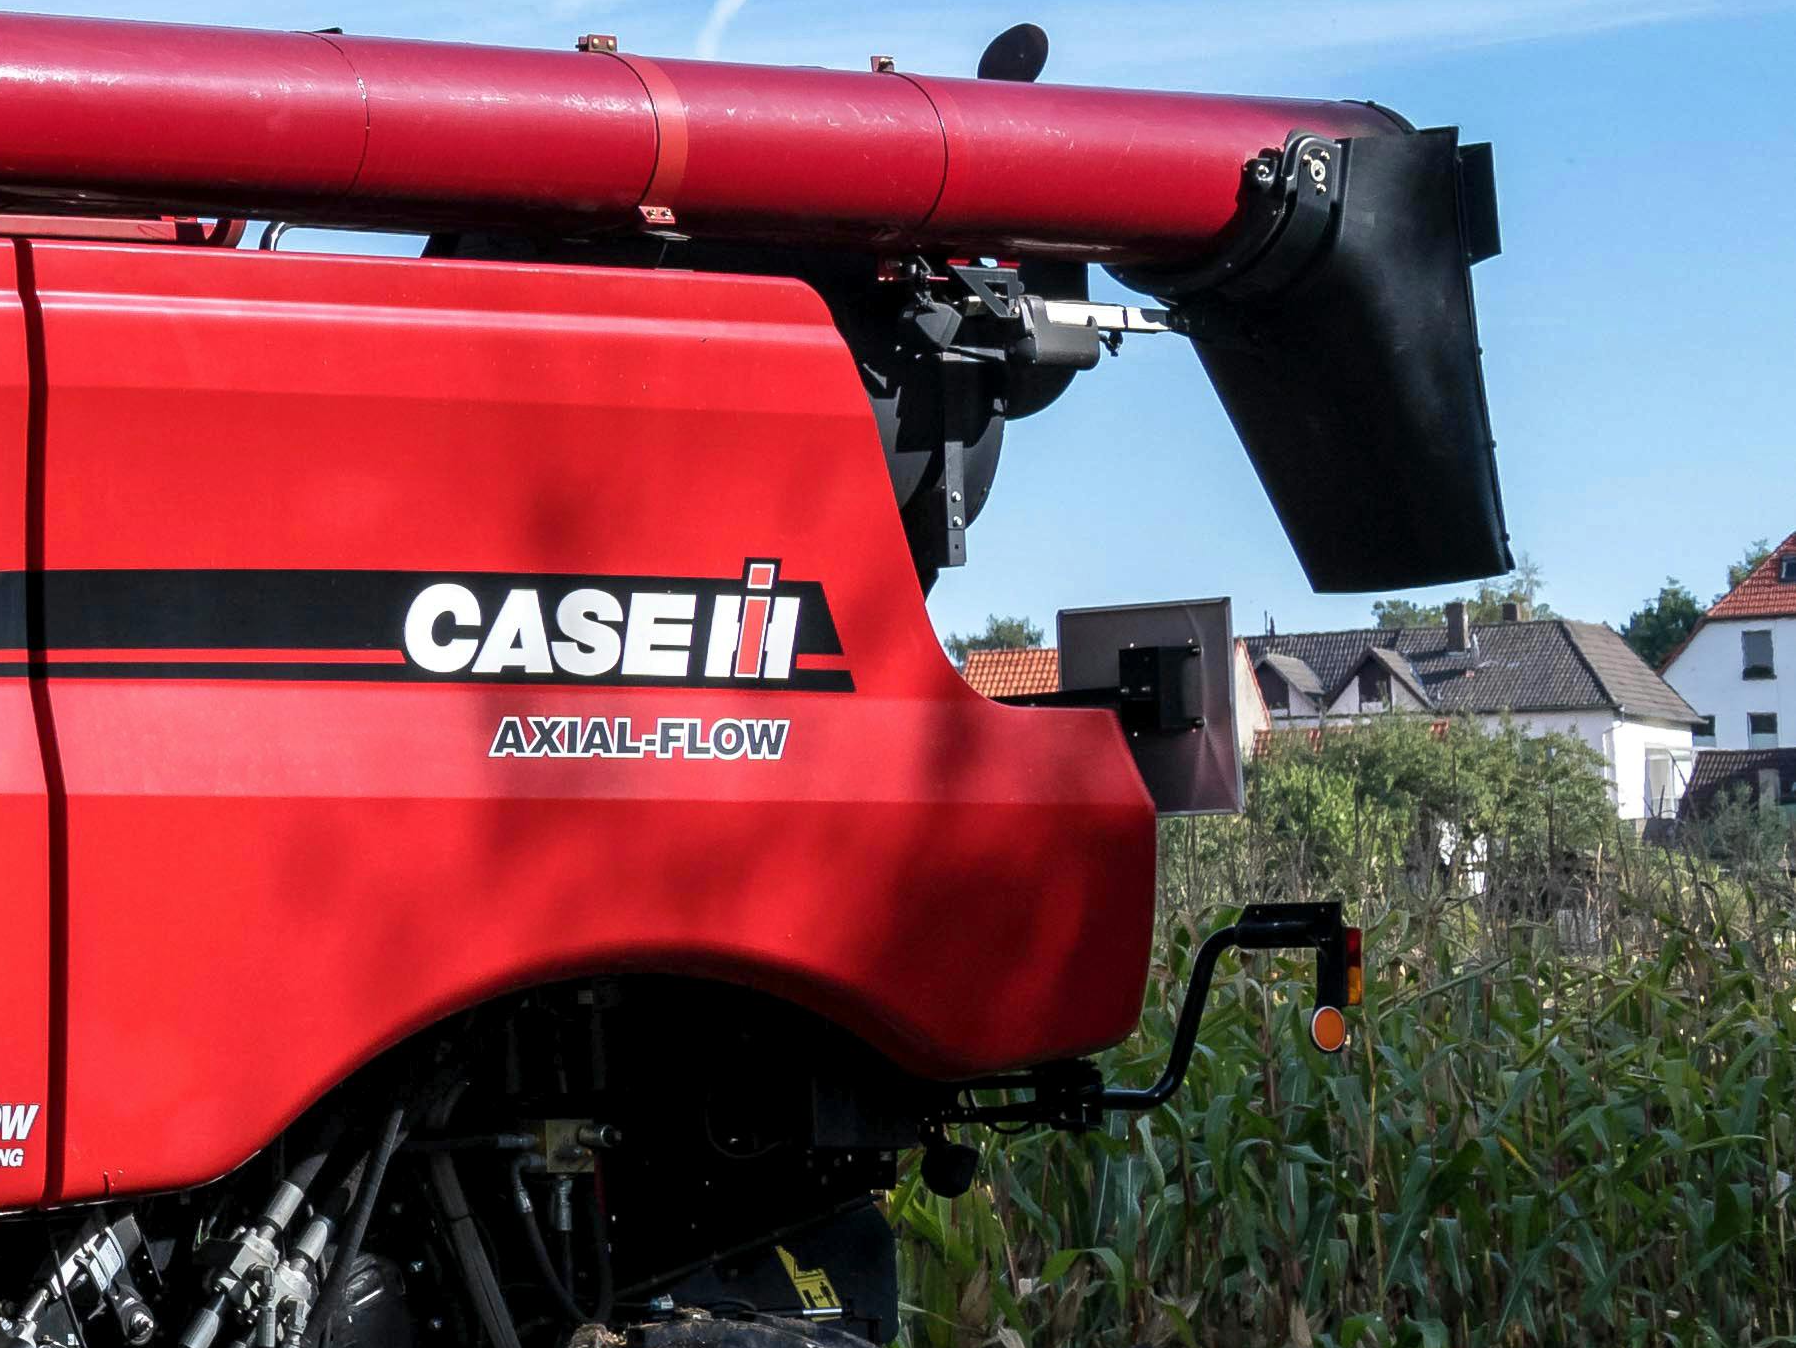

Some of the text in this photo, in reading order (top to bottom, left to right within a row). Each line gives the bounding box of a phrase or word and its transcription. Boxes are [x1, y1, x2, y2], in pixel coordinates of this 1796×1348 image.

[404, 563, 801, 679] CASE IH
[489, 716, 790, 760] AXIAL-FLOW
